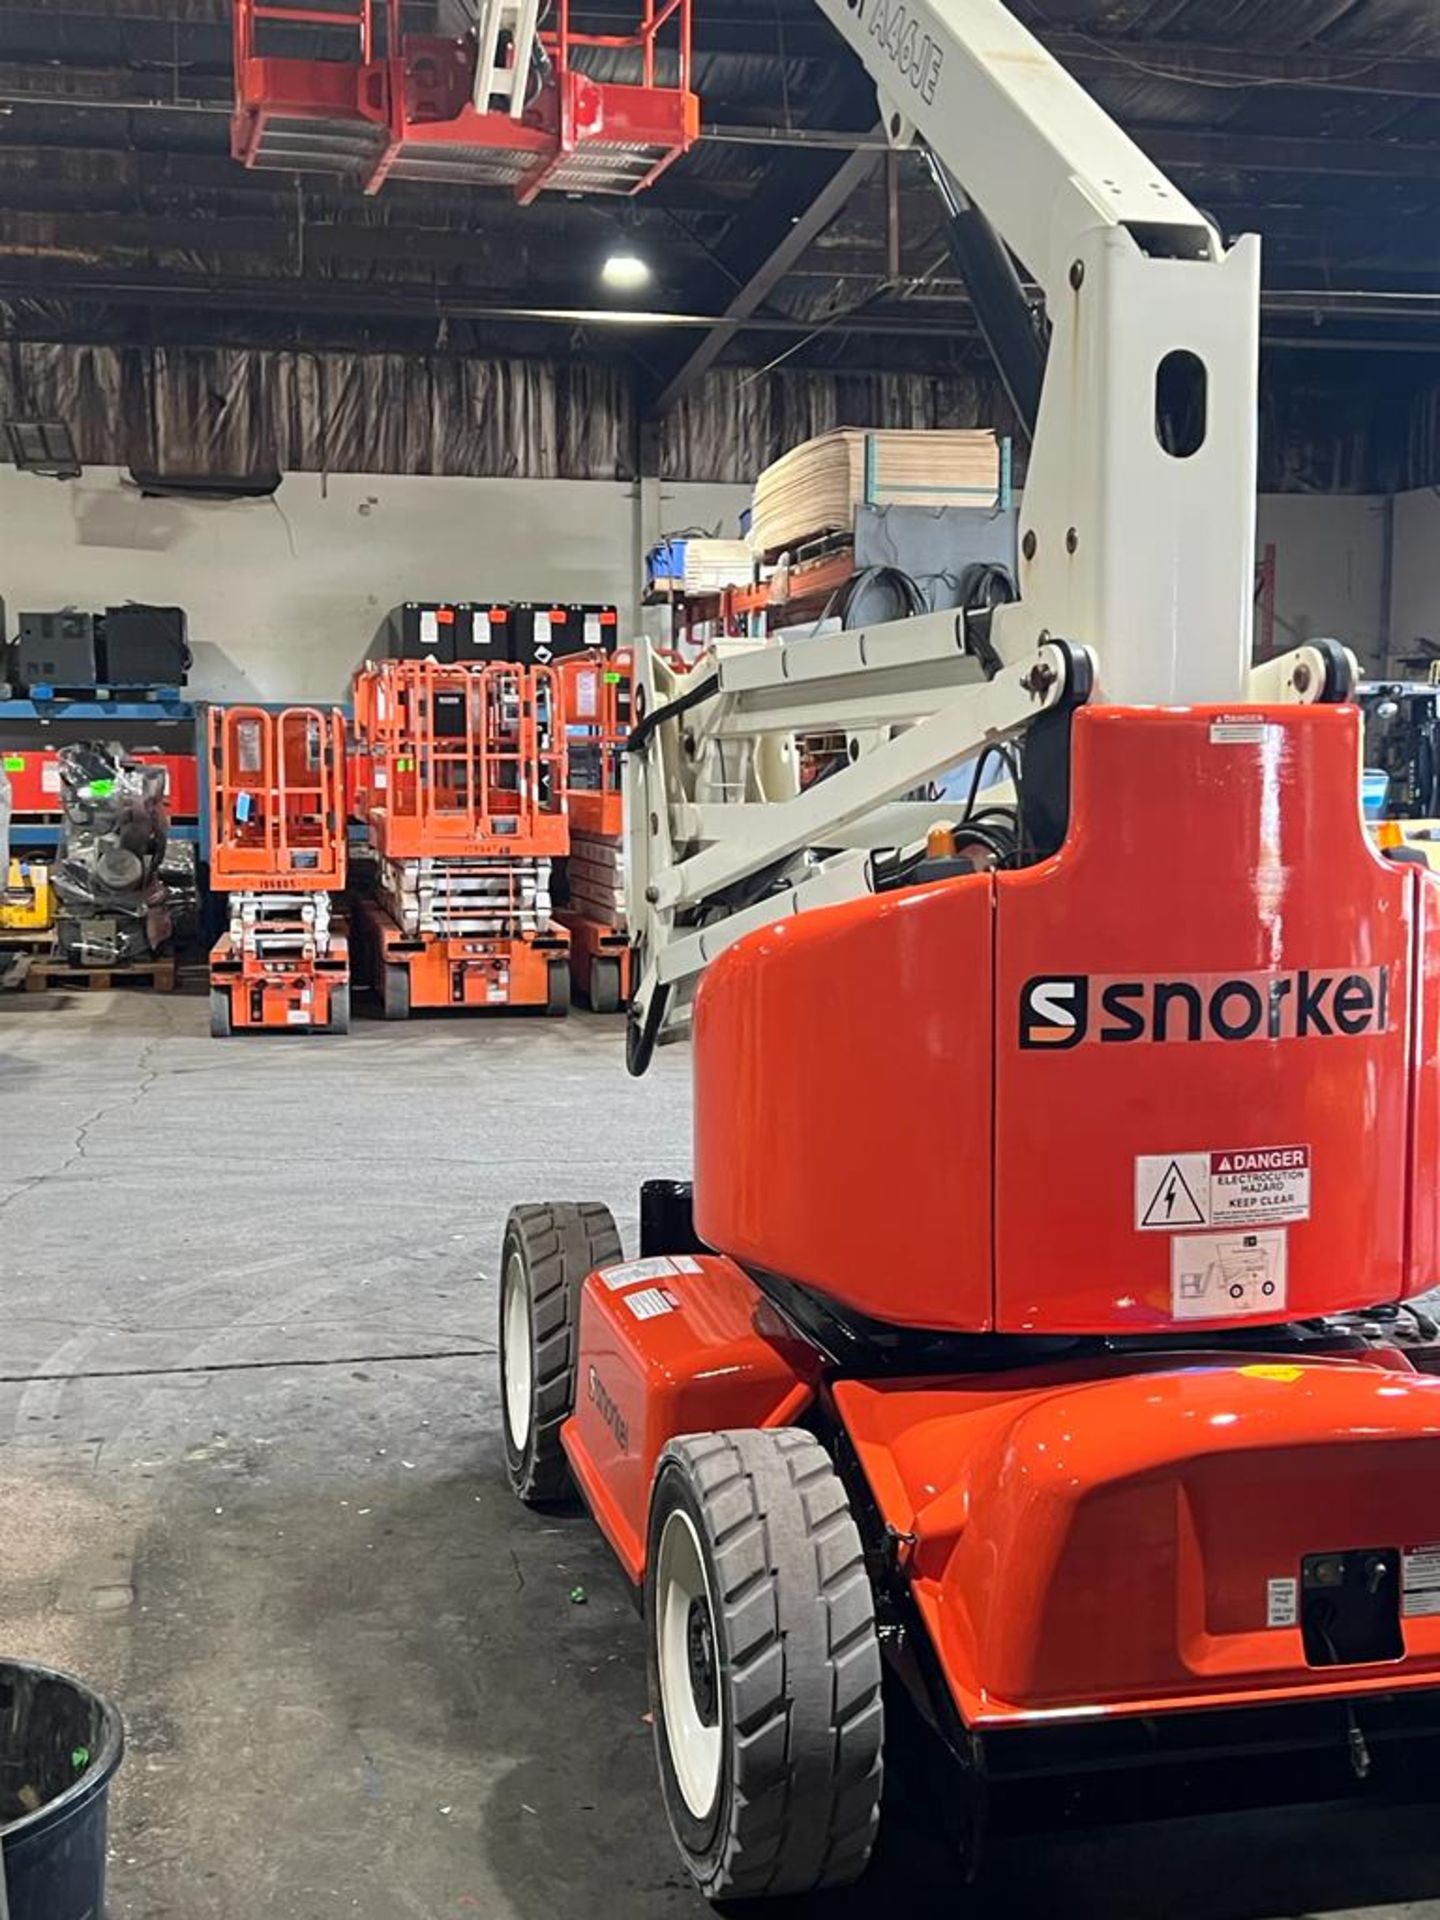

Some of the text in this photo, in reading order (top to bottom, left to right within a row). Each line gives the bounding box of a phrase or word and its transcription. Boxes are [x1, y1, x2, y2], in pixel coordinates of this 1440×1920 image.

[868, 0, 944, 106] A46JE
[1101, 965, 1389, 1042] snorkel
[1234, 1151, 1304, 1171] DANGER
[1218, 1172, 1304, 1186] ELECTROCUTION
[1241, 1182, 1285, 1194] HAZARD
[1229, 1194, 1295, 1208] KEEP CLEAR
